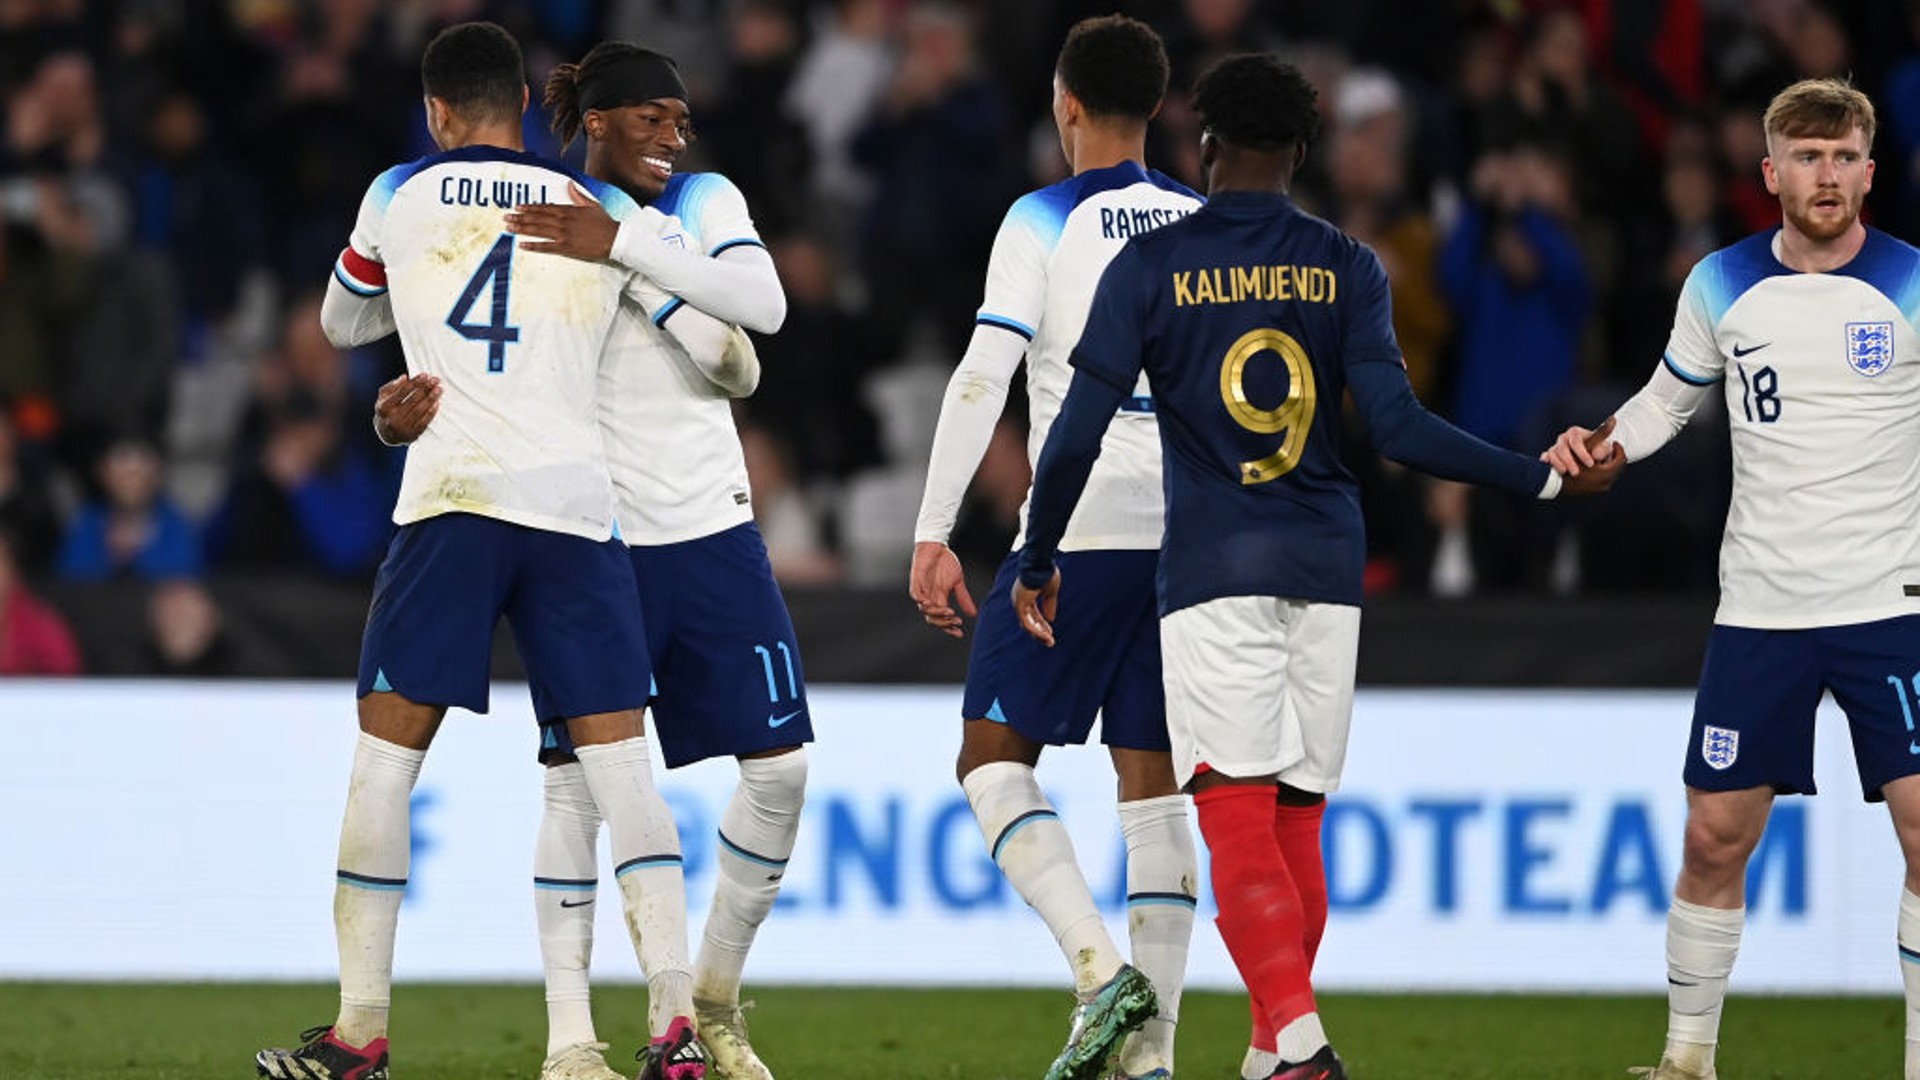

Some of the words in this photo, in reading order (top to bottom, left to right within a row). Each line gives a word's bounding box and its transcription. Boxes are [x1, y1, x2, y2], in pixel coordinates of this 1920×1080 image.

[1100, 207, 1189, 239] RAMS
[446, 232, 521, 373] 4
[1220, 327, 1317, 485] 9
[1737, 362, 1782, 423] 18
[754, 640, 798, 703] 11
